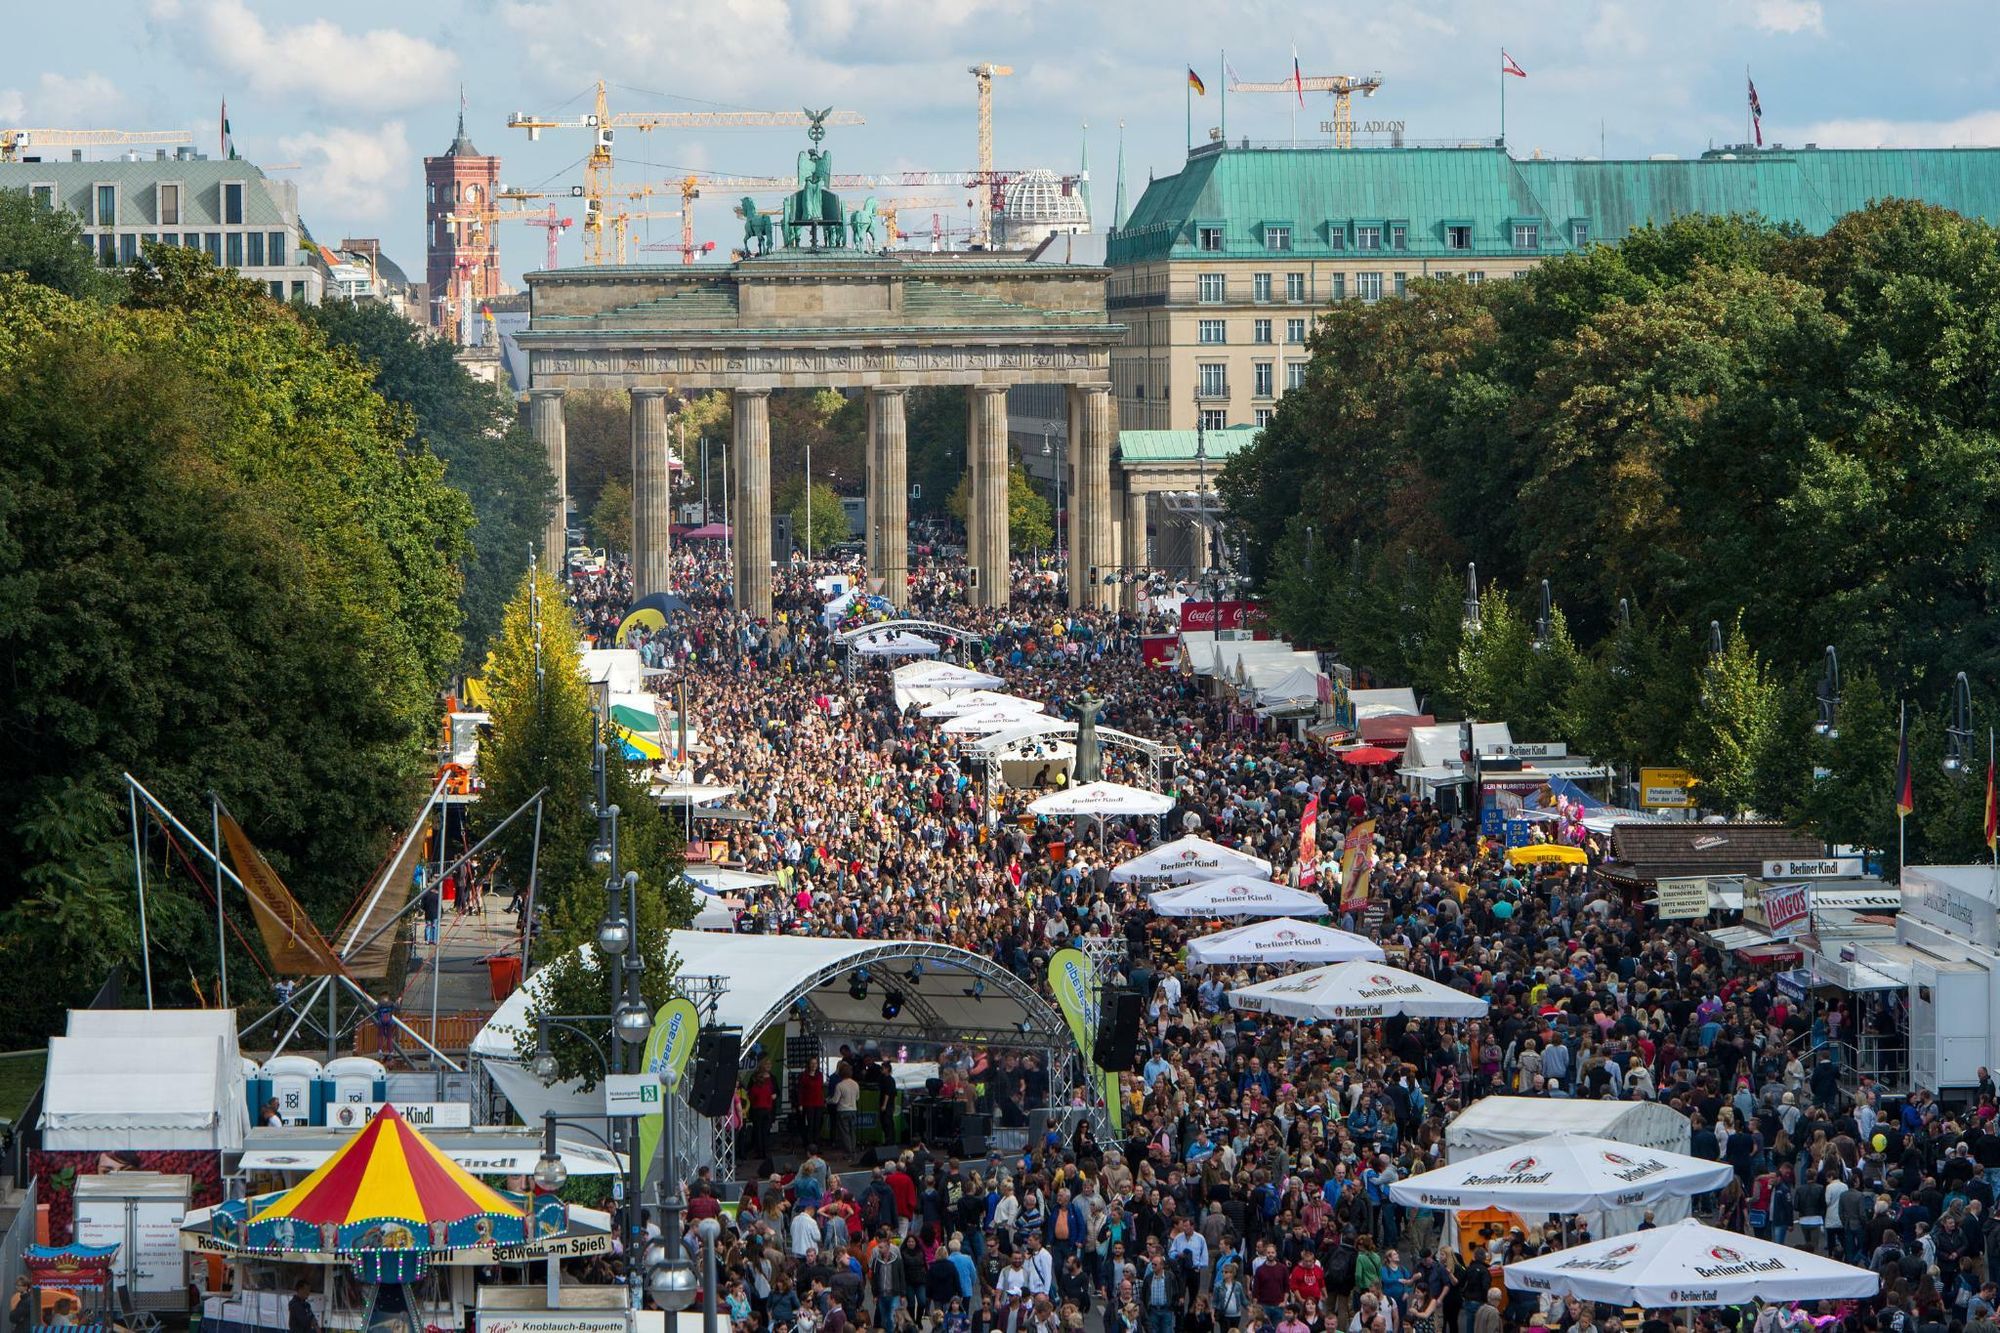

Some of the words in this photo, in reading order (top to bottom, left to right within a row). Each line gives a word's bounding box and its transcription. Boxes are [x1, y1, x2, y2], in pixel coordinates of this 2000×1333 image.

[1320, 121, 1360, 132] HOTEL
[1363, 121, 1405, 132] ADLON
[1509, 745, 1531, 756] Berliner
[1531, 745, 1548, 755] Kindl
[1565, 769, 1605, 778] Kindl
[1160, 861, 1194, 871] Berliner
[1194, 860, 1218, 868] Kindl
[1790, 862, 1818, 874] Berliner
[1818, 862, 1838, 874] Kindl
[1139, 874, 1158, 883] Berliner
[1158, 874, 1173, 882] Kindl
[1211, 896, 1246, 904] Berliner
[1247, 894, 1273, 902] Kindl
[1255, 941, 1294, 950] Berliner
[1294, 938, 1321, 946] Kindl
[1236, 955, 1252, 963] Berliner
[1252, 954, 1264, 962] Kindl
[1358, 986, 1396, 999] Berliner
[1396, 983, 1421, 995] Kindl
[1345, 1006, 1367, 1016] Berliner
[1367, 1004, 1383, 1015] Kindl
[407, 1107, 434, 1124] Kindl
[1461, 1173, 1510, 1186] Berliner
[1509, 1171, 1552, 1185] Kindl
[1429, 1194, 1448, 1206] Berliner
[1448, 1195, 1461, 1207] Kindl
[548, 1243, 568, 1255] am
[571, 1236, 606, 1256] Spieß
[1694, 1261, 1750, 1278] Berliner
[1750, 1257, 1787, 1272] Kindl
[1680, 1290, 1702, 1302] Berliner
[1702, 1289, 1718, 1301] Kindl
[522, 1321, 623, 1333] Knoblauch-Baguette
